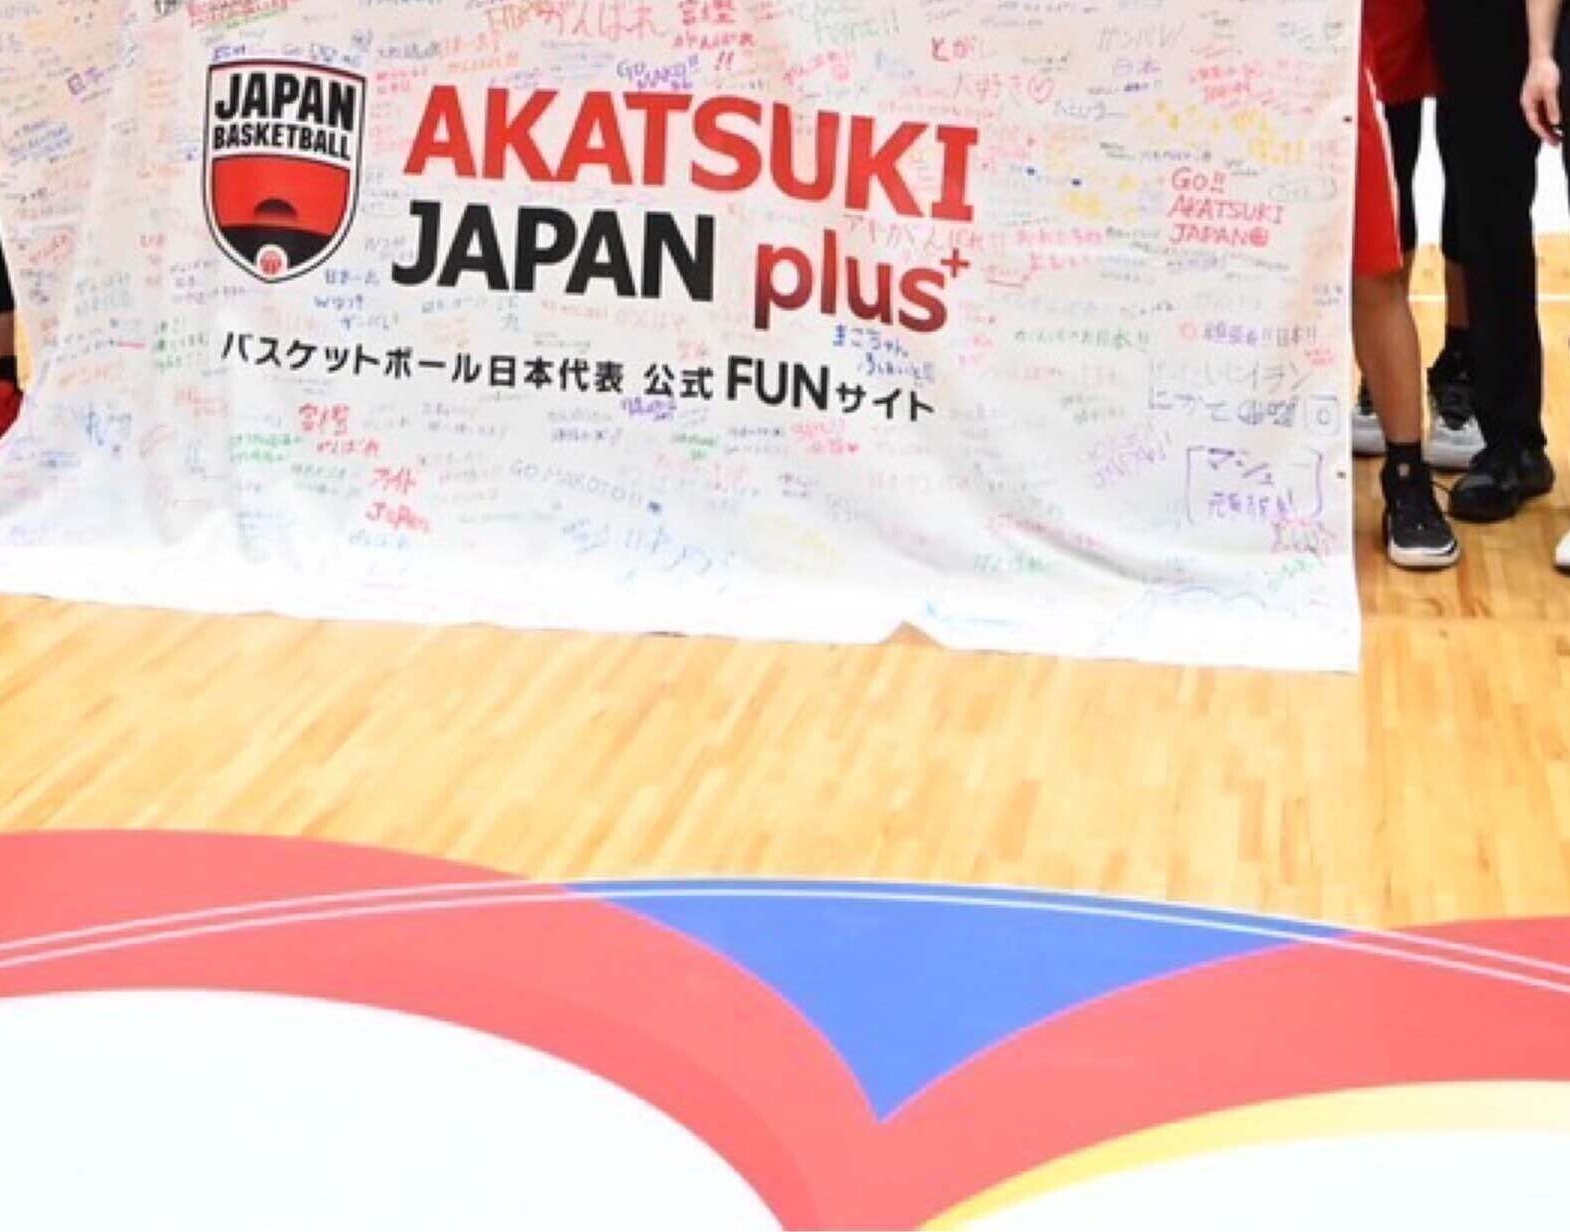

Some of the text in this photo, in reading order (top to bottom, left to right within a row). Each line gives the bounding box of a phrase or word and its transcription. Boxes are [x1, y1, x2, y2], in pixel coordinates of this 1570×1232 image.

[213, 70, 357, 132] JAPAN
[212, 123, 353, 164] BASKETBALL
[404, 85, 979, 223] AKATSUKI
[391, 201, 716, 303] JAPAN
[221, 331, 624, 395] バスケットボール日本代表
[643, 364, 714, 400] 公式
